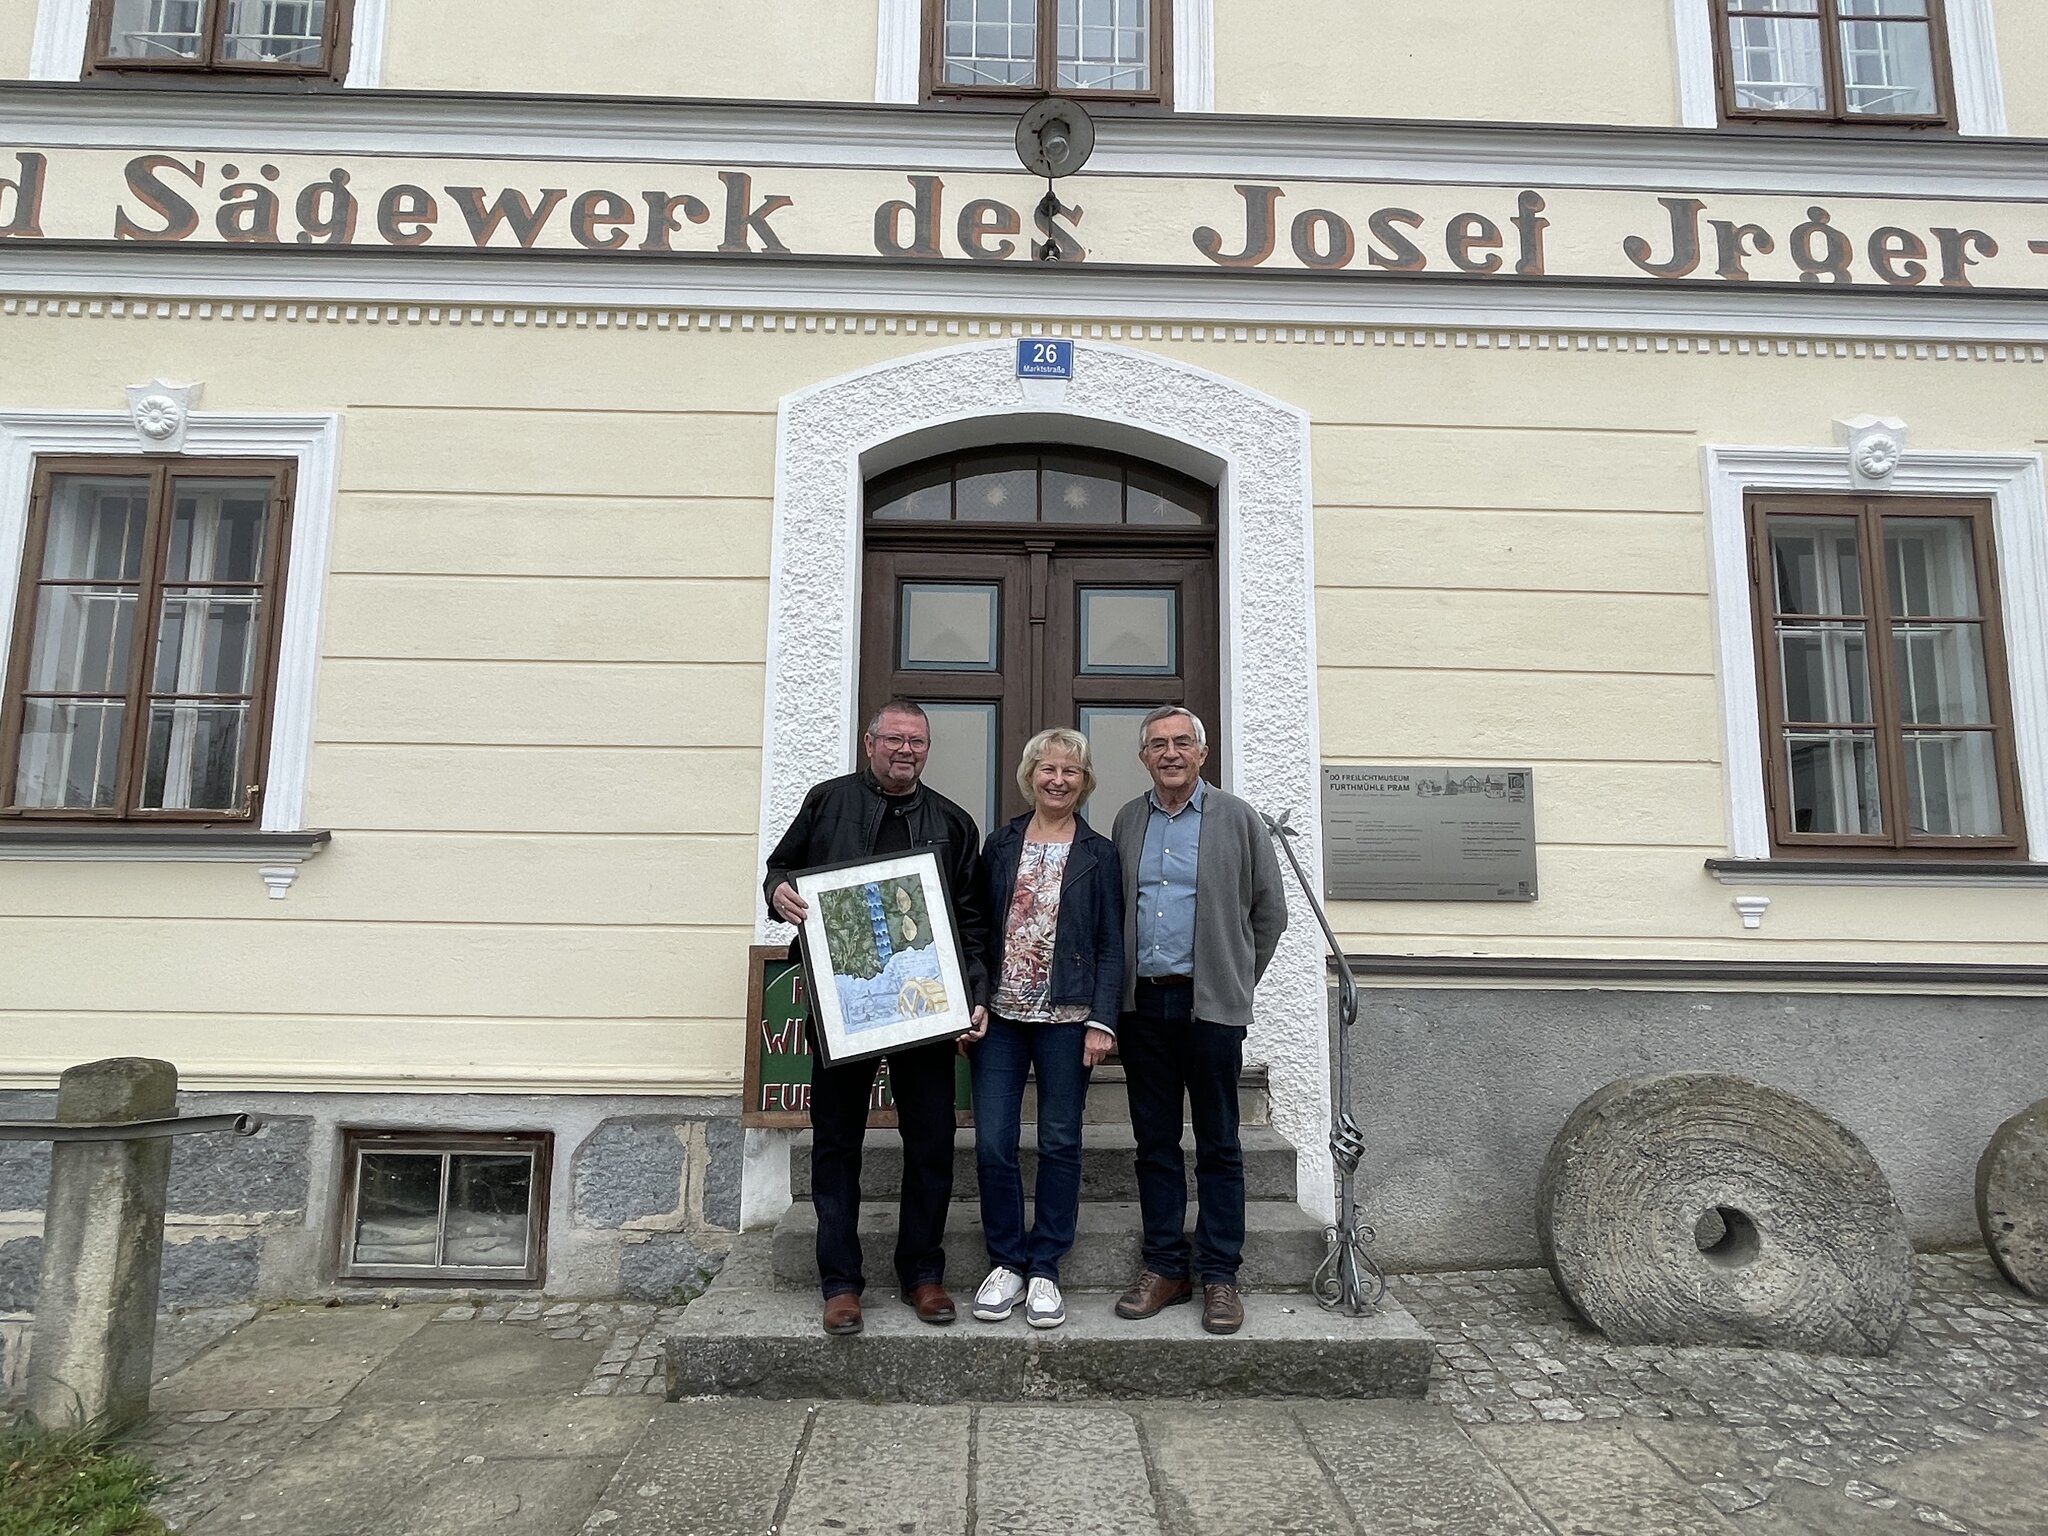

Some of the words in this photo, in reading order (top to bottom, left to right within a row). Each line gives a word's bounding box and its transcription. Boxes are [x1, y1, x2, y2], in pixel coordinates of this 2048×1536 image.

[113, 154, 794, 253] Sägewerk
[873, 174, 1086, 262] des
[1192, 184, 1550, 276] Josef
[1032, 343, 1057, 363] 26
[1023, 364, 1066, 374] Marktstraße
[1341, 774, 1410, 782] FREILICHTMUSEUM
[1330, 782, 1385, 791] FURTHMÜHLE
